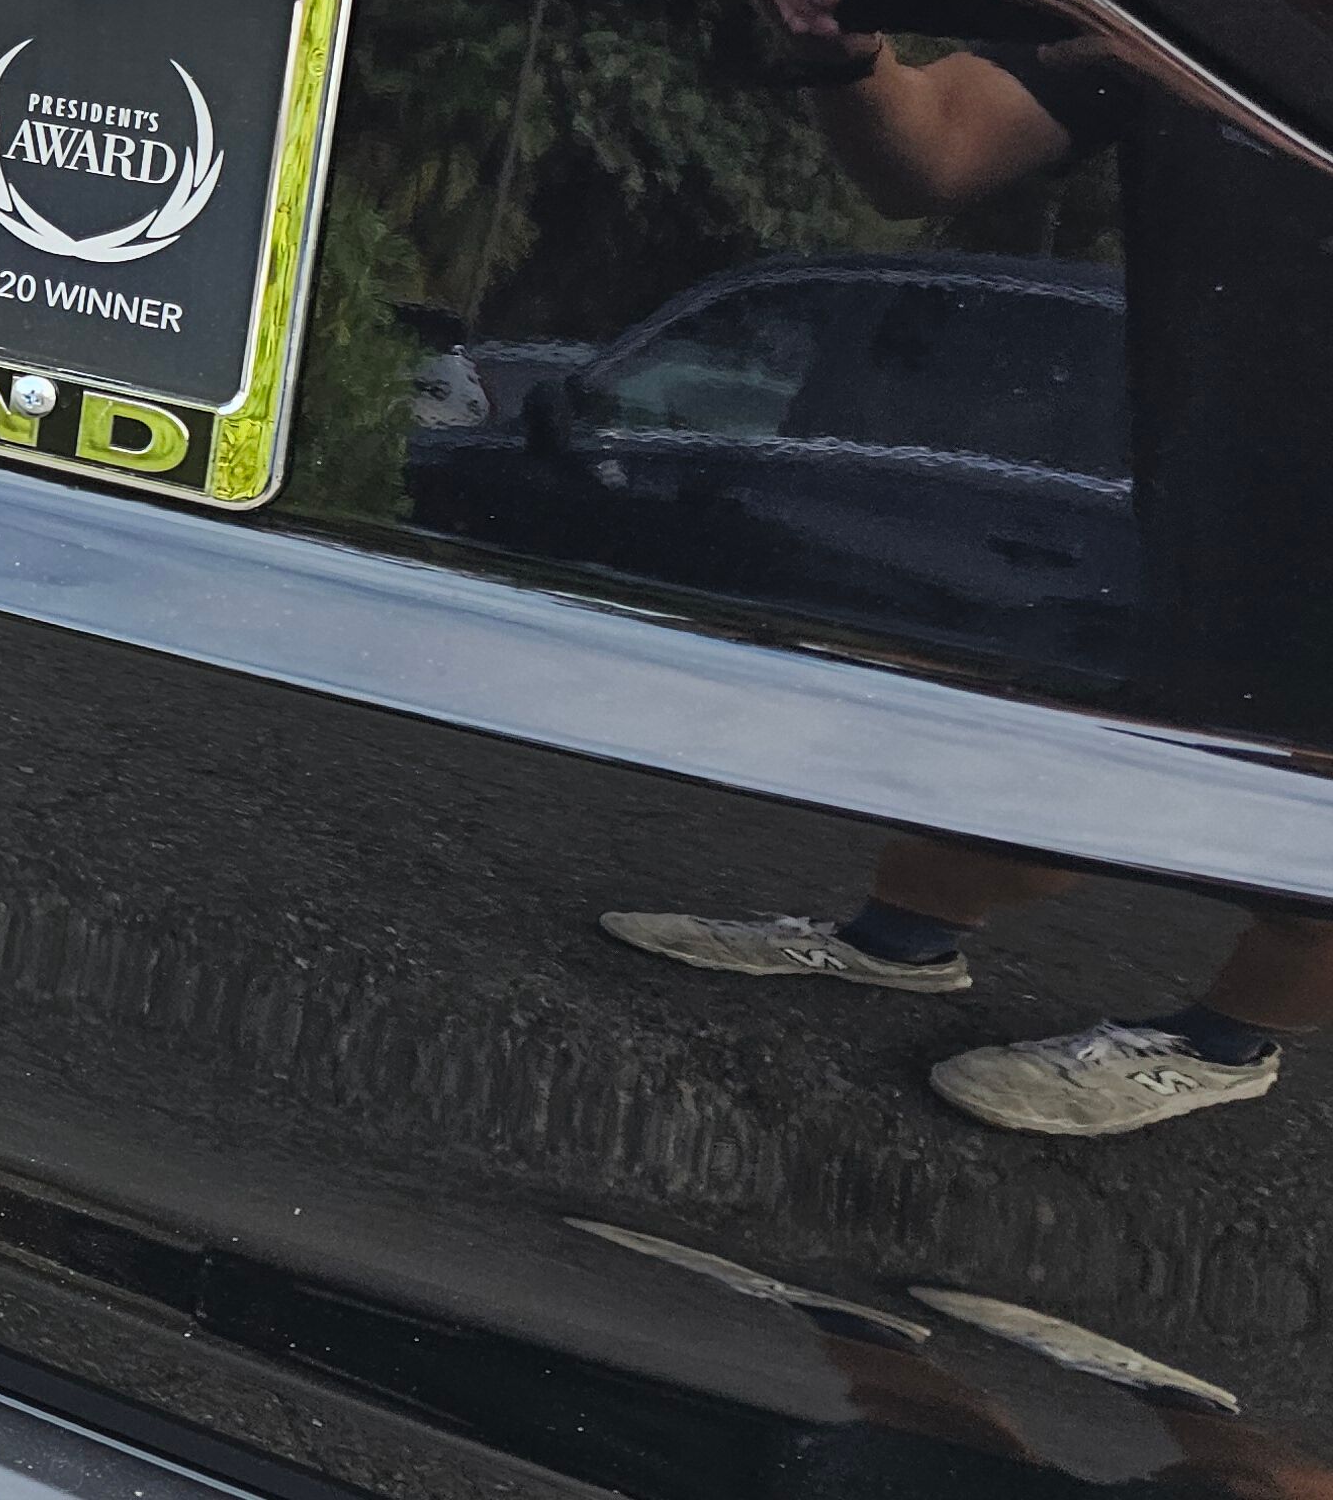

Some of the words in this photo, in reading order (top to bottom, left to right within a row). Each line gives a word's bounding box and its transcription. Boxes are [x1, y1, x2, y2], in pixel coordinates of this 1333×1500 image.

[28, 93, 160, 133] PRESIDENT'S
[2, 118, 177, 184] AWARD
[44, 278, 183, 333] WINNER
